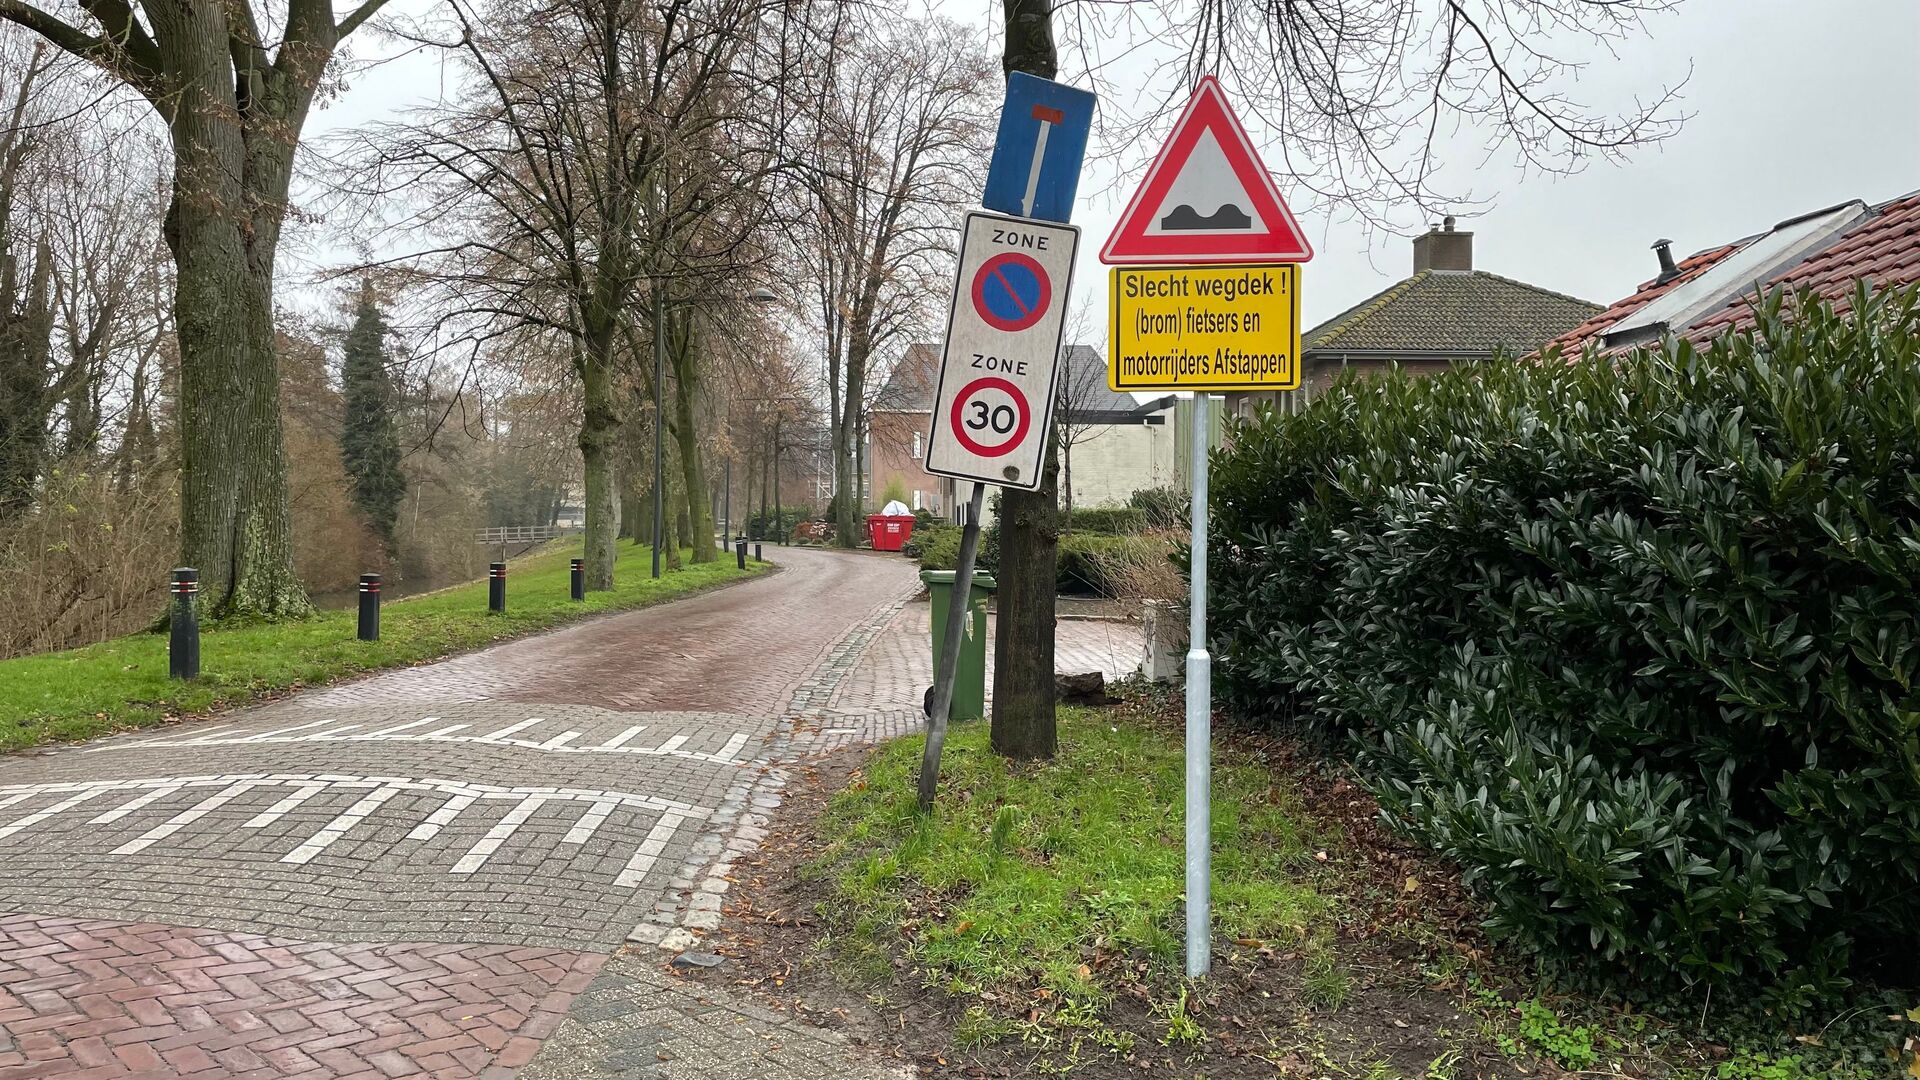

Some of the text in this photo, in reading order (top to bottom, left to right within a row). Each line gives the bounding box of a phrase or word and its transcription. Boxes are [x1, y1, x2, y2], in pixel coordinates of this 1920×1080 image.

[992, 229, 1049, 251] ZONE
[1125, 274, 1189, 298] Slecht
[1195, 271, 1274, 301] wegdek
[1136, 307, 1260, 341] (brom) fietsers en
[971, 353, 1028, 376] ZONE
[1123, 347, 1286, 382] motorrijders Afstappen
[966, 400, 1015, 434] 30
